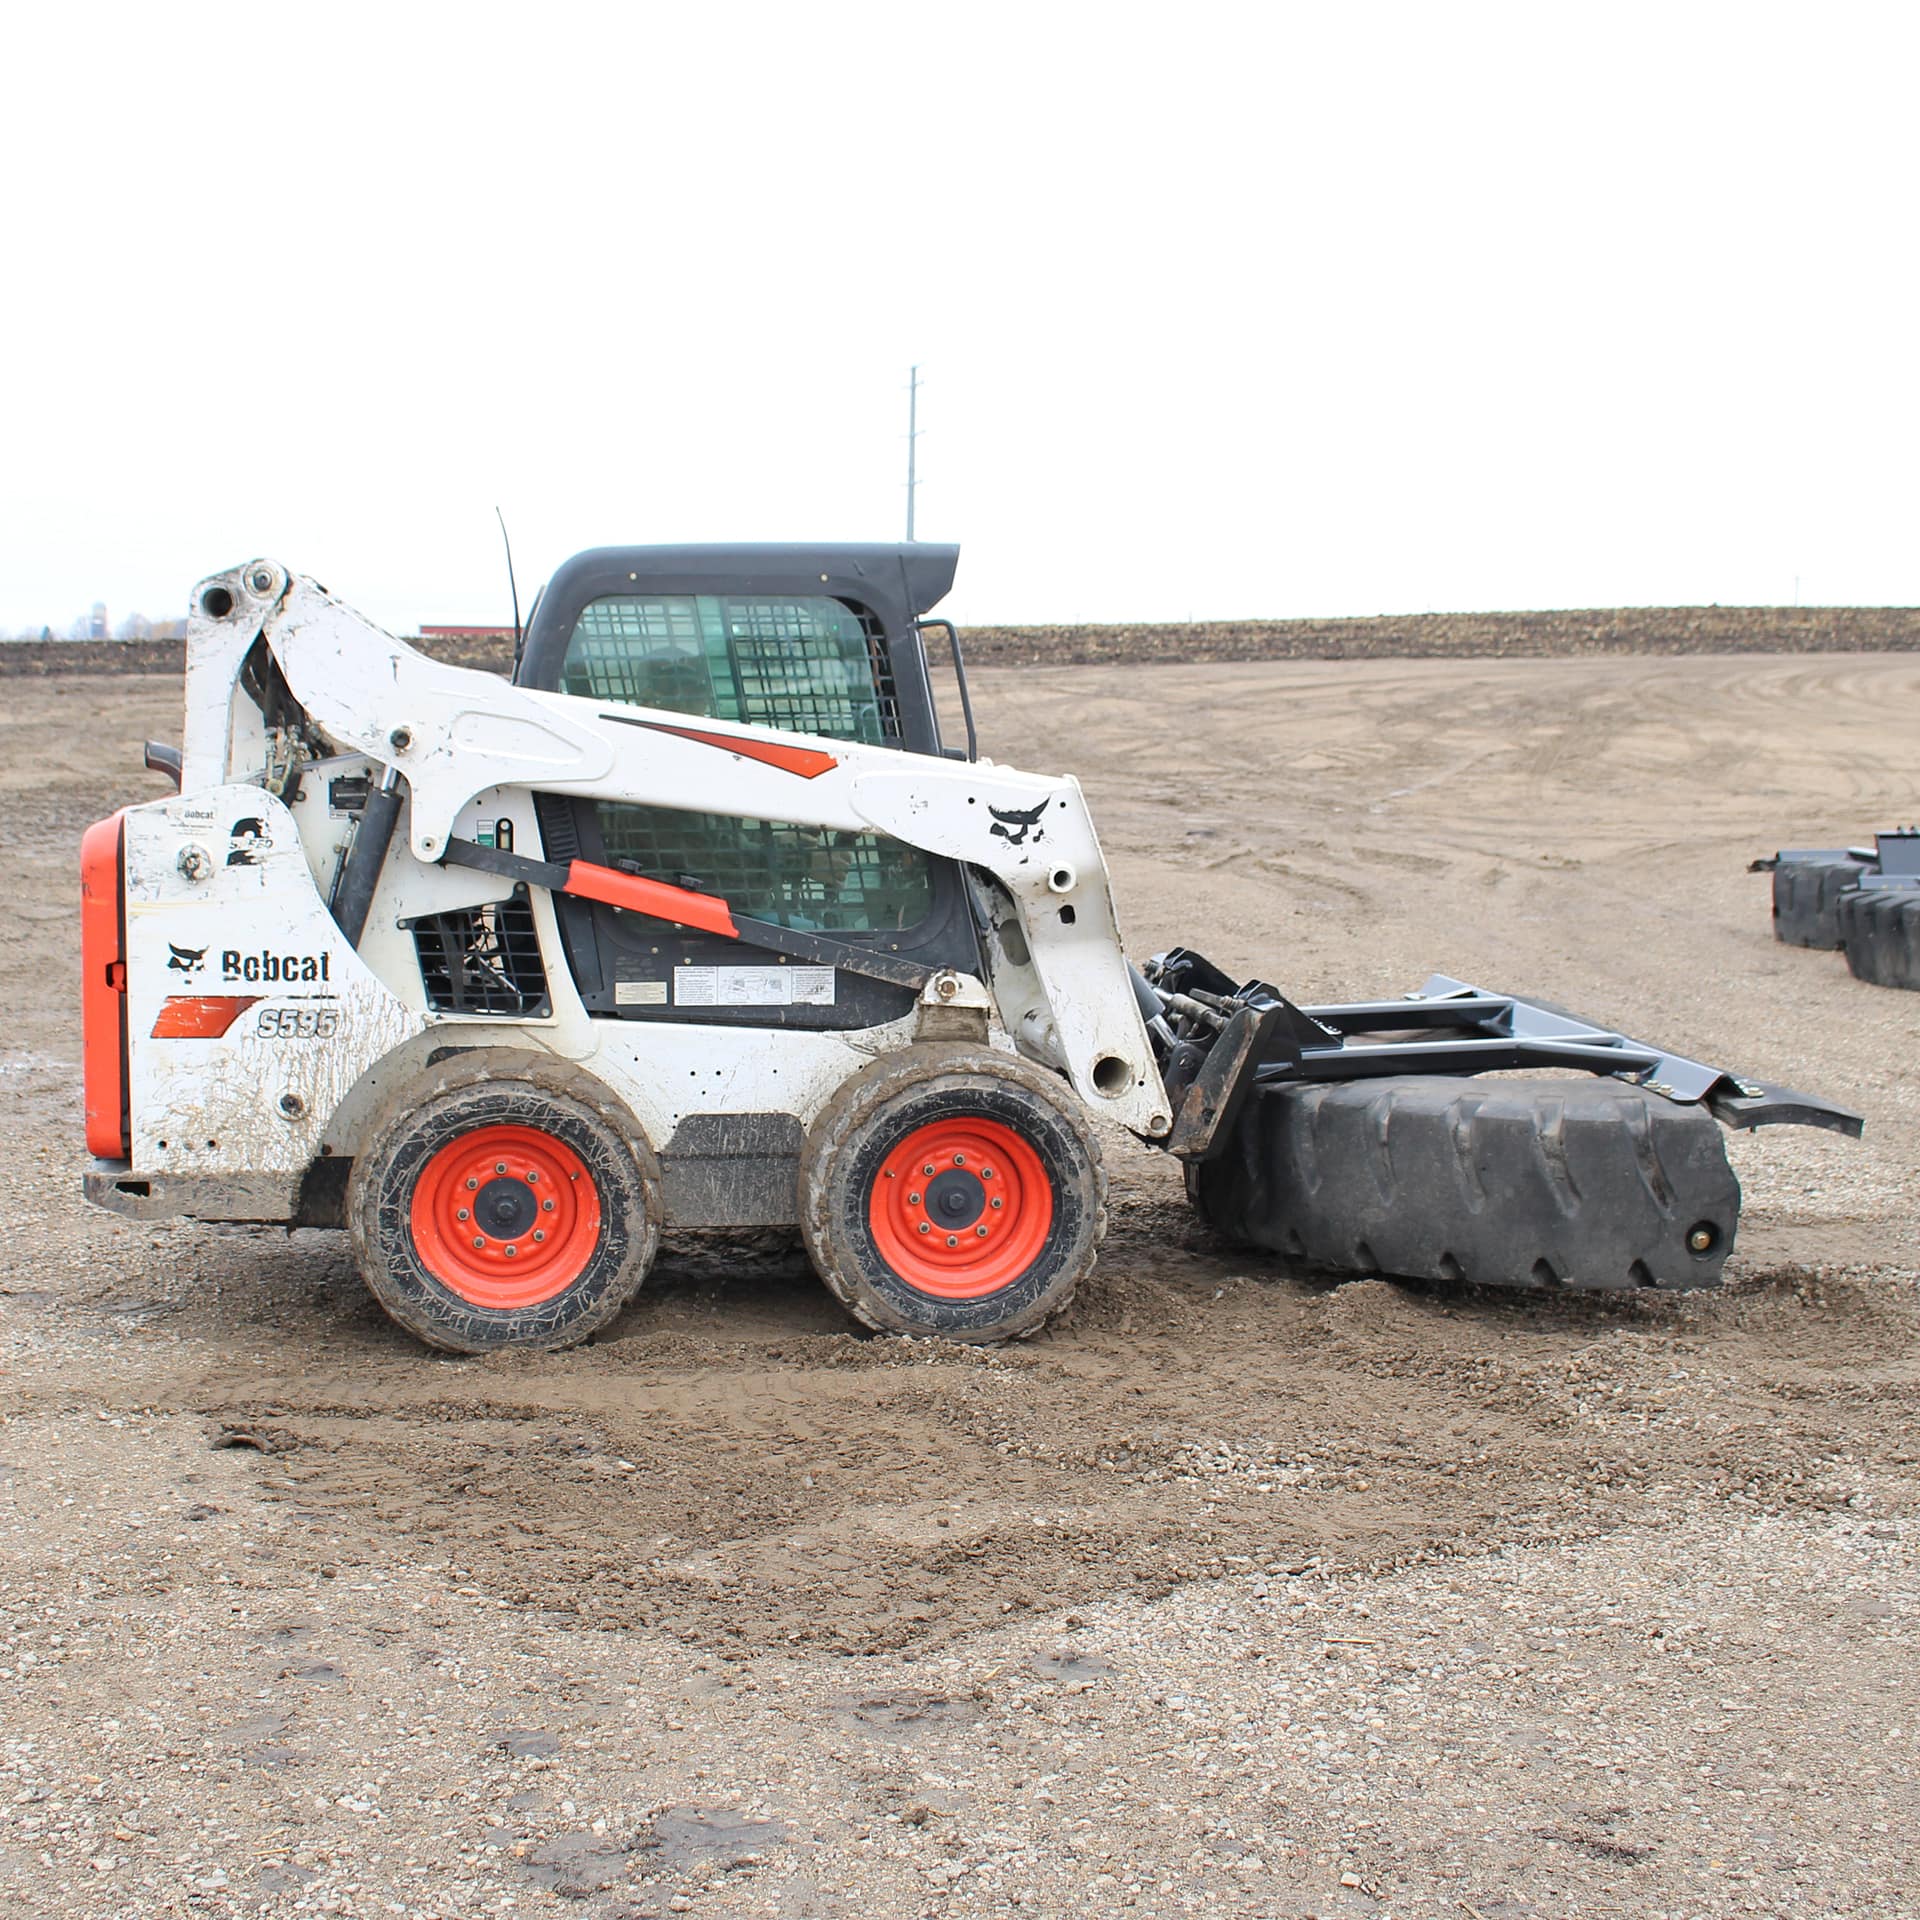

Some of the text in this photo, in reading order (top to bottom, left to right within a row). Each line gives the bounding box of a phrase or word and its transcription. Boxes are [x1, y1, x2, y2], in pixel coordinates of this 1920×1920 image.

[229, 839, 273, 849] SEED
[222, 950, 330, 982] Bobcat
[257, 1008, 339, 1039] S595
